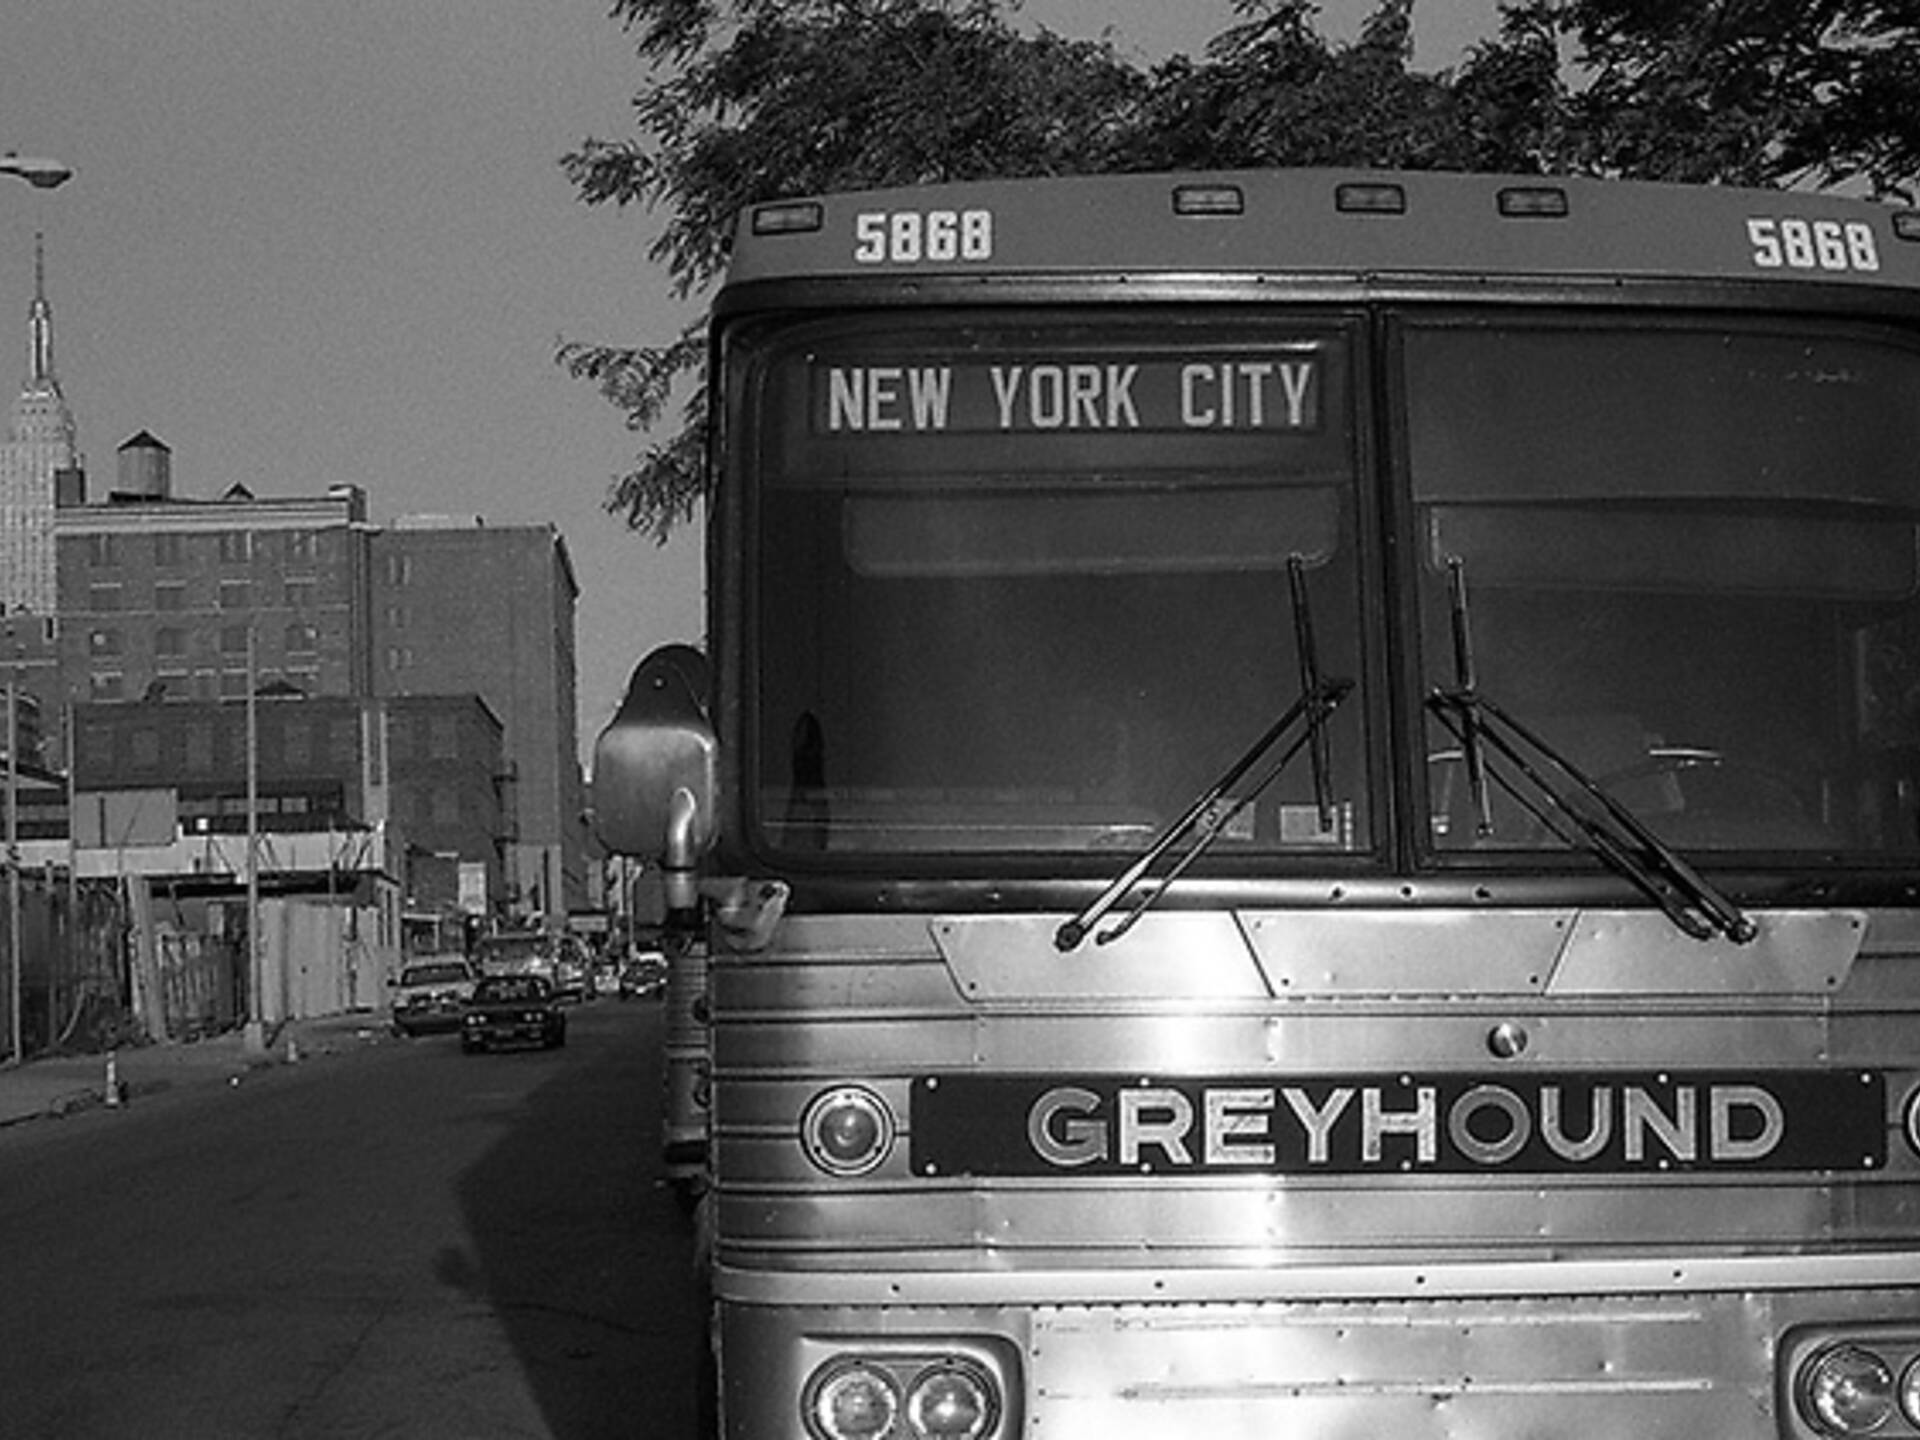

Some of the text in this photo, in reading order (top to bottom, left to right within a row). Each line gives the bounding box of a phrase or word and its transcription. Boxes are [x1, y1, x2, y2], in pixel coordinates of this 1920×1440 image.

[855, 210, 992, 262] 5868
[1747, 219, 1880, 271] 5868
[829, 363, 1311, 430] NEW YORK CITY
[1027, 1086, 1785, 1165] GREYHOUND
